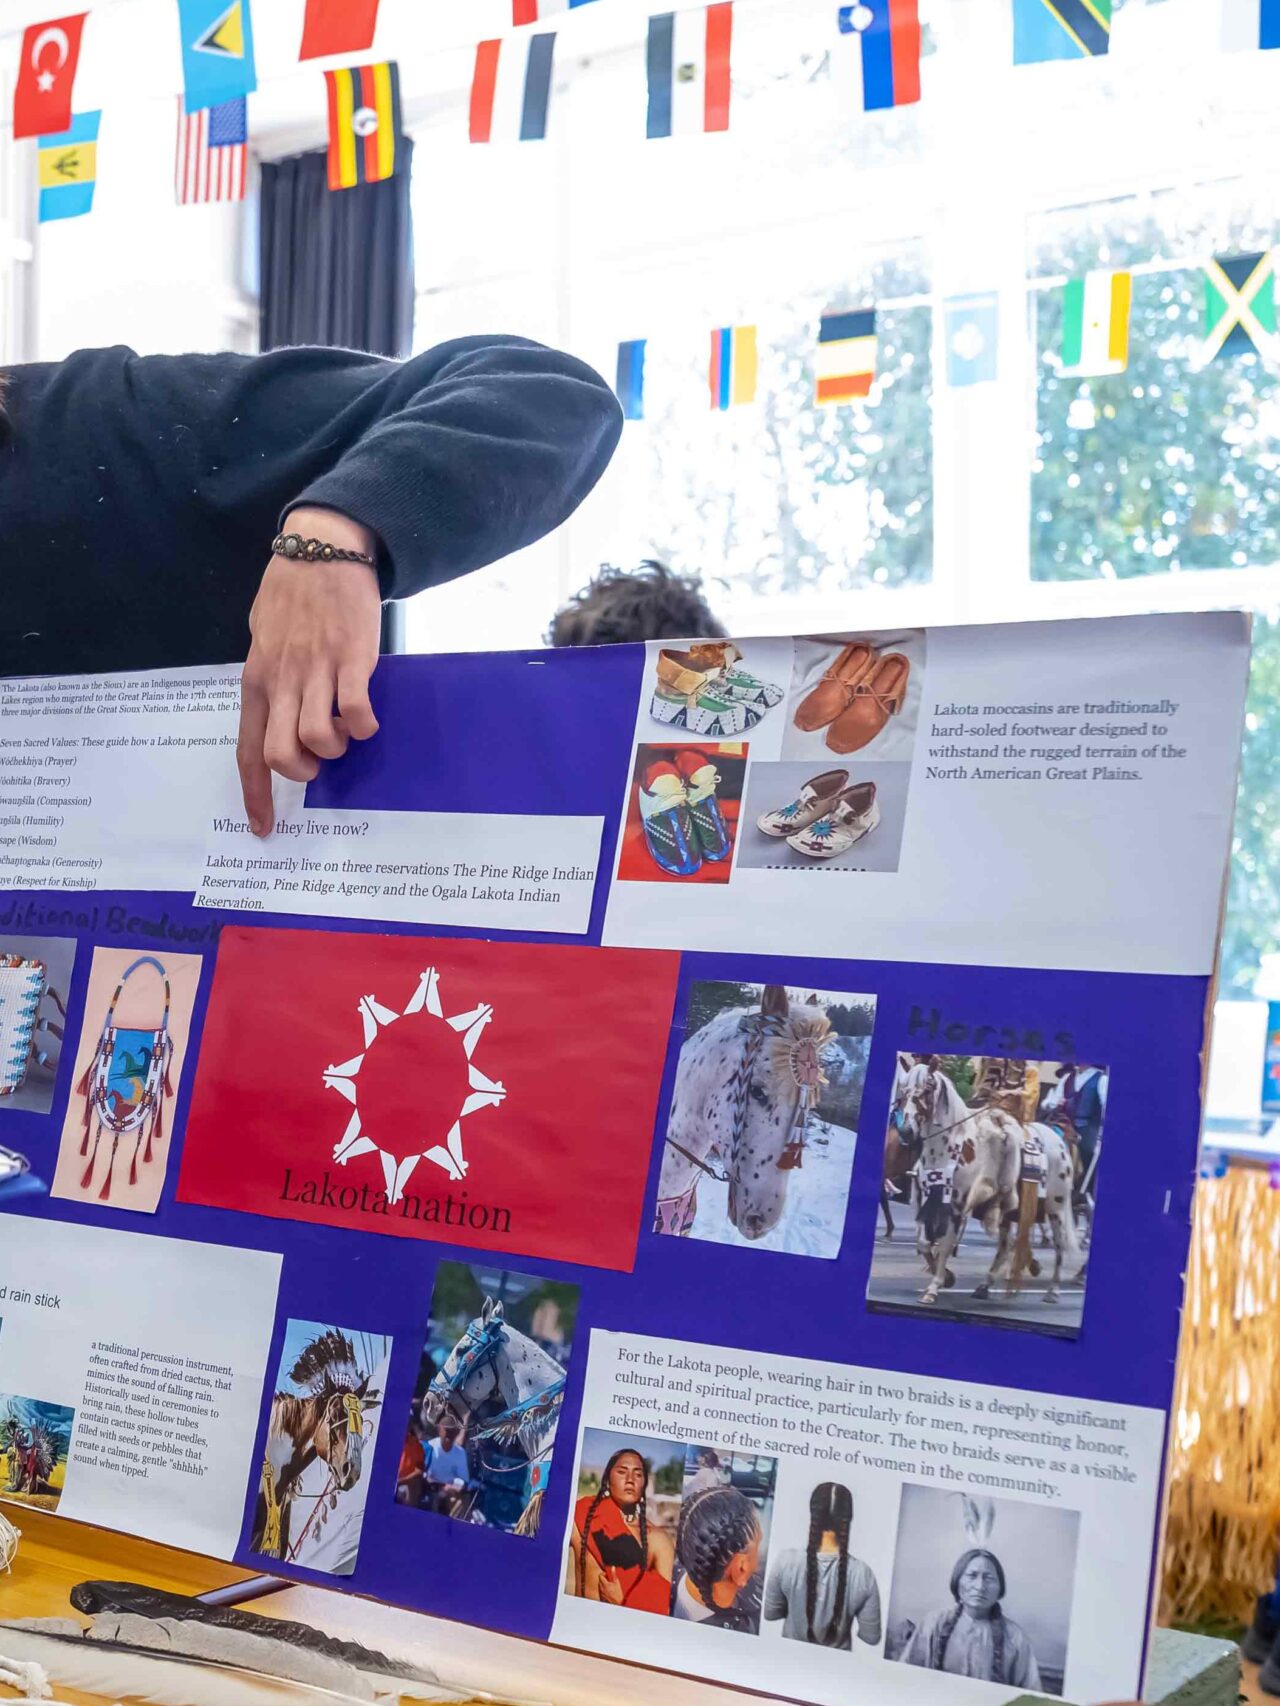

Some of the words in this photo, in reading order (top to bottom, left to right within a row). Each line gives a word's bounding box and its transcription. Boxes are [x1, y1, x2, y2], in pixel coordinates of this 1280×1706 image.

[934, 703, 978, 715] Lakota
[983, 703, 1053, 714] moccasins
[1057, 705, 1079, 714] are
[1084, 700, 1180, 715] traditionally
[0, 739, 21, 747] Seven
[23, 737, 49, 747] Sacred
[51, 737, 79, 746] Values:
[81, 736, 104, 746] These
[105, 736, 129, 748] guide
[130, 736, 148, 746] how
[157, 736, 185, 745] Lakota
[187, 738, 217, 747] person
[931, 723, 1006, 736] hard-soled
[1011, 723, 1076, 735] footwear
[1079, 722, 1147, 738] designed
[1152, 724, 1167, 735] to
[929, 744, 998, 757] withstand
[1003, 745, 1025, 757] the
[1030, 745, 1081, 760] rugged
[1085, 745, 1137, 757] terrain
[1141, 744, 1159, 757] of
[1161, 744, 1186, 757] the
[926, 766, 967, 778] North
[971, 767, 1041, 779] American
[1045, 767, 1086, 779] Great
[1092, 767, 1141, 780] Plains.
[276, 820, 302, 837] they
[306, 820, 330, 834] live
[333, 822, 369, 836] now?
[206, 855, 242, 867] Lakota
[245, 857, 298, 872] primarily
[300, 857, 321, 870] live
[323, 862, 338, 871] on
[342, 859, 372, 872] three
[375, 863, 448, 875] reservations
[453, 863, 476, 876] The
[480, 864, 508, 877] Pine
[512, 865, 548, 881] Ridge
[552, 866, 594, 881] Indian
[202, 875, 269, 890] Reservation,
[273, 878, 298, 890] Pine
[301, 879, 334, 895] Ridge
[337, 882, 380, 896] Agency
[382, 883, 406, 895] and
[409, 883, 428, 896] the
[432, 884, 467, 900] Ogala
[471, 886, 513, 900] Lakota
[518, 888, 559, 902] Indian
[196, 895, 265, 910] Reservation.
[278, 1168, 388, 1214] Lakota
[399, 1192, 512, 1232] nation
[9, 1289, 31, 1302] rain
[34, 1293, 60, 1308] stick
[89, 1354, 109, 1365] often
[110, 1360, 138, 1371] crafted
[140, 1363, 159, 1376] from
[161, 1367, 182, 1380] dried
[184, 1375, 212, 1387] cactus,
[214, 1378, 231, 1390] that
[98, 1342, 139, 1357] traditional
[140, 1351, 183, 1365] percussion
[185, 1357, 233, 1376] instrument,
[84, 1381, 129, 1400] Historically
[131, 1393, 150, 1403] used
[151, 1395, 159, 1405] in
[161, 1400, 208, 1415] ceremonies
[210, 1409, 219, 1418] to
[618, 1348, 640, 1362] For
[643, 1351, 663, 1365] the
[668, 1354, 711, 1372] Lakota
[715, 1364, 762, 1380] people,
[767, 1372, 821, 1391] wearing
[826, 1375, 855, 1392] hair
[859, 1380, 872, 1395] in
[877, 1385, 904, 1399] two
[908, 1387, 953, 1406] braids
[959, 1394, 971, 1408] is
[975, 1401, 983, 1410] a
[988, 1399, 1038, 1420] deeply
[1043, 1408, 1125, 1430] significant
[615, 1371, 664, 1387] cultural
[667, 1379, 692, 1392] and
[695, 1383, 751, 1400] spiritual
[755, 1393, 813, 1411] practice,
[818, 1402, 900, 1424] particularly
[905, 1410, 927, 1426] for
[931, 1418, 967, 1433] men,
[973, 1425, 1070, 1450] representing
[1076, 1435, 1128, 1456] honor,
[79, 1411, 108, 1424] contain
[110, 1419, 135, 1429] cactus
[136, 1424, 162, 1435] spines
[164, 1430, 173, 1438] or
[175, 1432, 207, 1447] needles,
[612, 1394, 660, 1411] respect,
[664, 1401, 689, 1414] and
[692, 1406, 699, 1416] a
[704, 1408, 777, 1427] connection
[782, 1418, 795, 1430] to
[800, 1419, 822, 1434] the
[826, 1423, 883, 1443] Creator.
[888, 1432, 916, 1448] The
[921, 1439, 948, 1453] two
[952, 1441, 999, 1461] braids
[1004, 1454, 1045, 1468] serve
[1049, 1461, 1066, 1471] as
[1070, 1464, 1079, 1474] a
[1085, 1463, 1136, 1482] visible
[73, 1454, 97, 1465] sound
[99, 1458, 119, 1470] when
[121, 1463, 148, 1477] tipped.
[75, 1440, 99, 1451] create
[107, 1446, 139, 1462] calming,
[141, 1455, 167, 1466] gentle
[609, 1414, 717, 1440] acknowledgment
[722, 1431, 737, 1444] of
[739, 1432, 760, 1448] the
[764, 1441, 809, 1455] sacred
[813, 1446, 840, 1461] role
[844, 1450, 860, 1463] of
[863, 1456, 915, 1472] women
[920, 1461, 934, 1476] in
[940, 1464, 963, 1480] the
[967, 1473, 1059, 1497] community.
